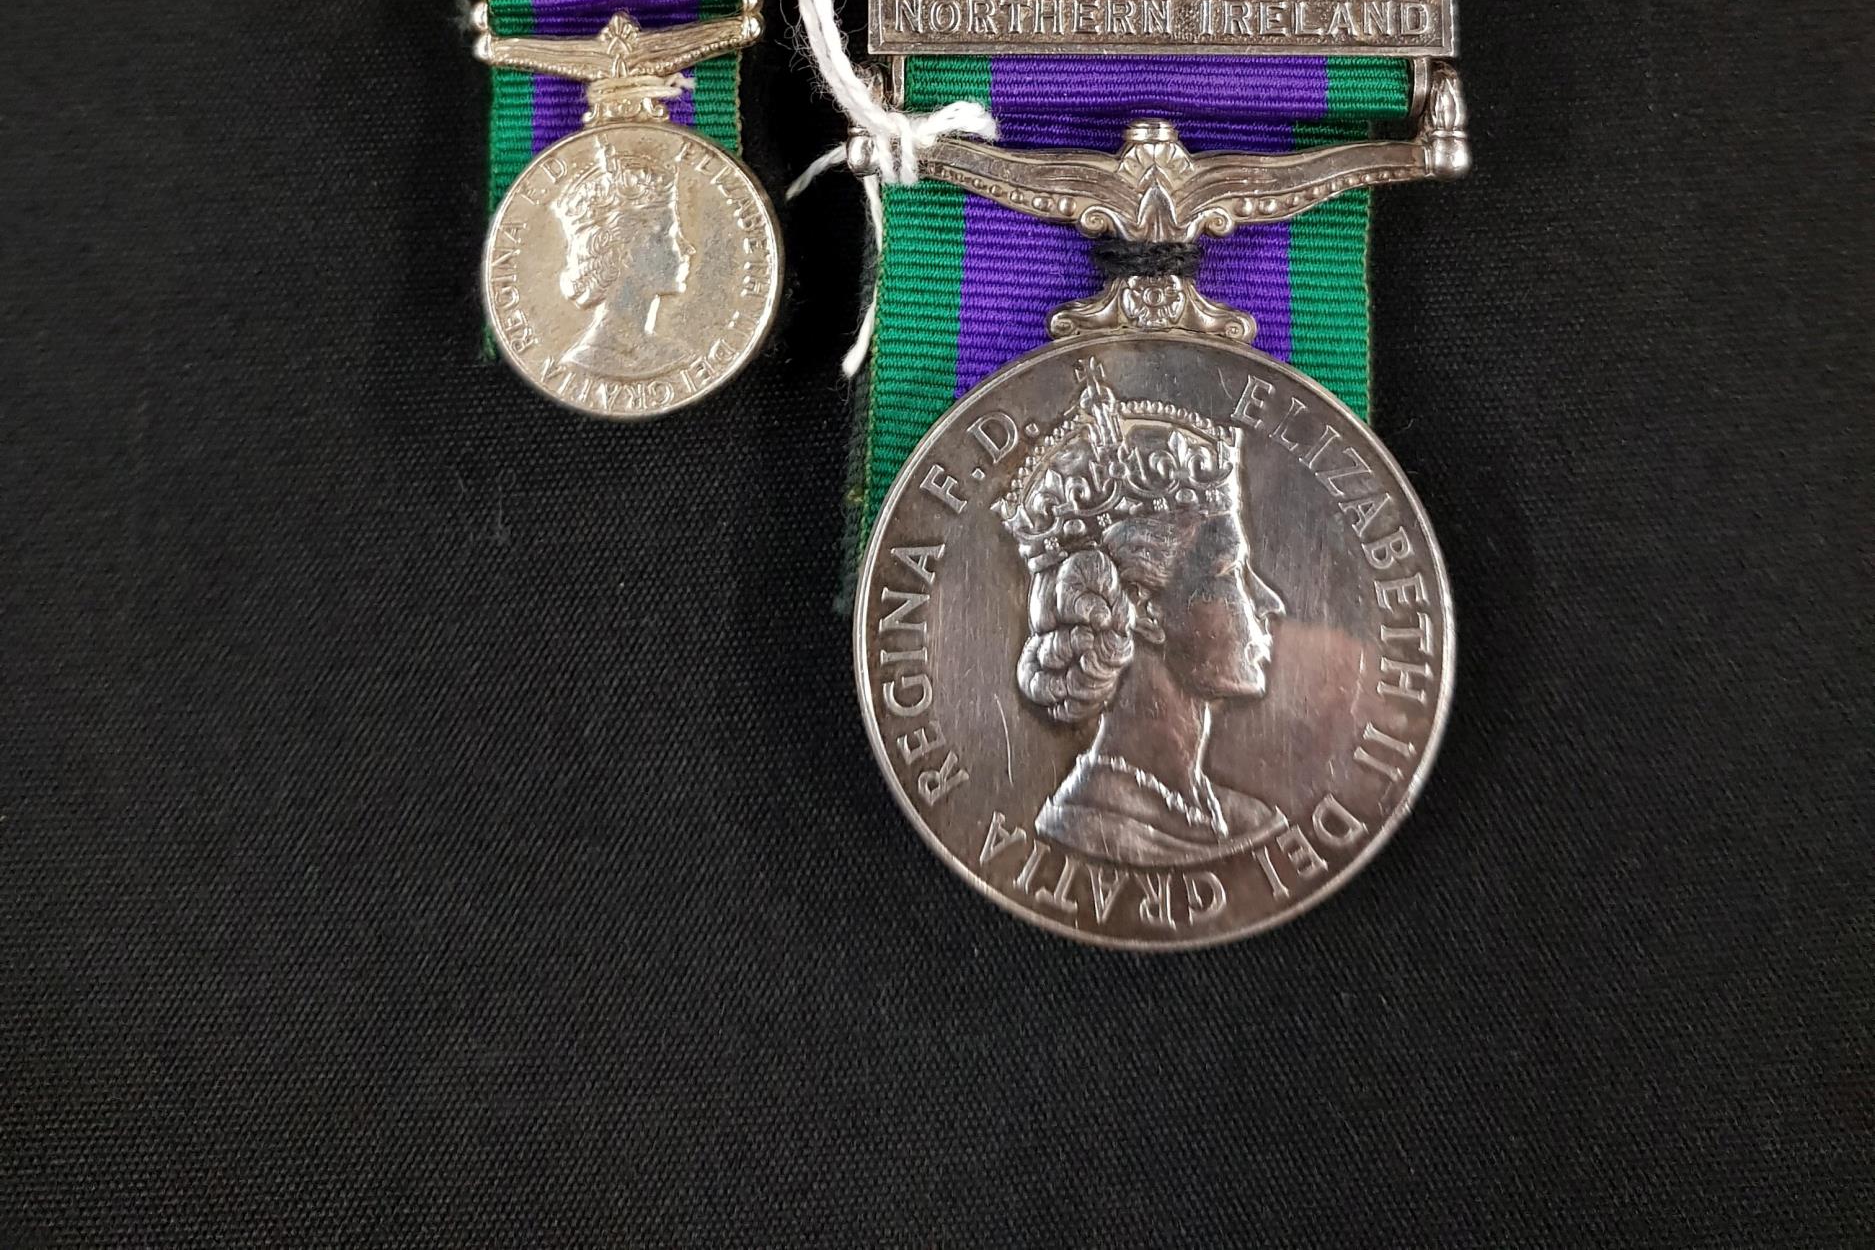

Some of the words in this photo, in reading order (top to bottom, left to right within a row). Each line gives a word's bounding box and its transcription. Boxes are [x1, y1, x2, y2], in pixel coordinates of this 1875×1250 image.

[1229, 374, 1435, 703] ELIZABETH
[880, 543, 970, 808] REGINA
[1353, 722, 1417, 783] II
[979, 810, 1229, 931] GRATIA
[1252, 793, 1369, 900] DEI
